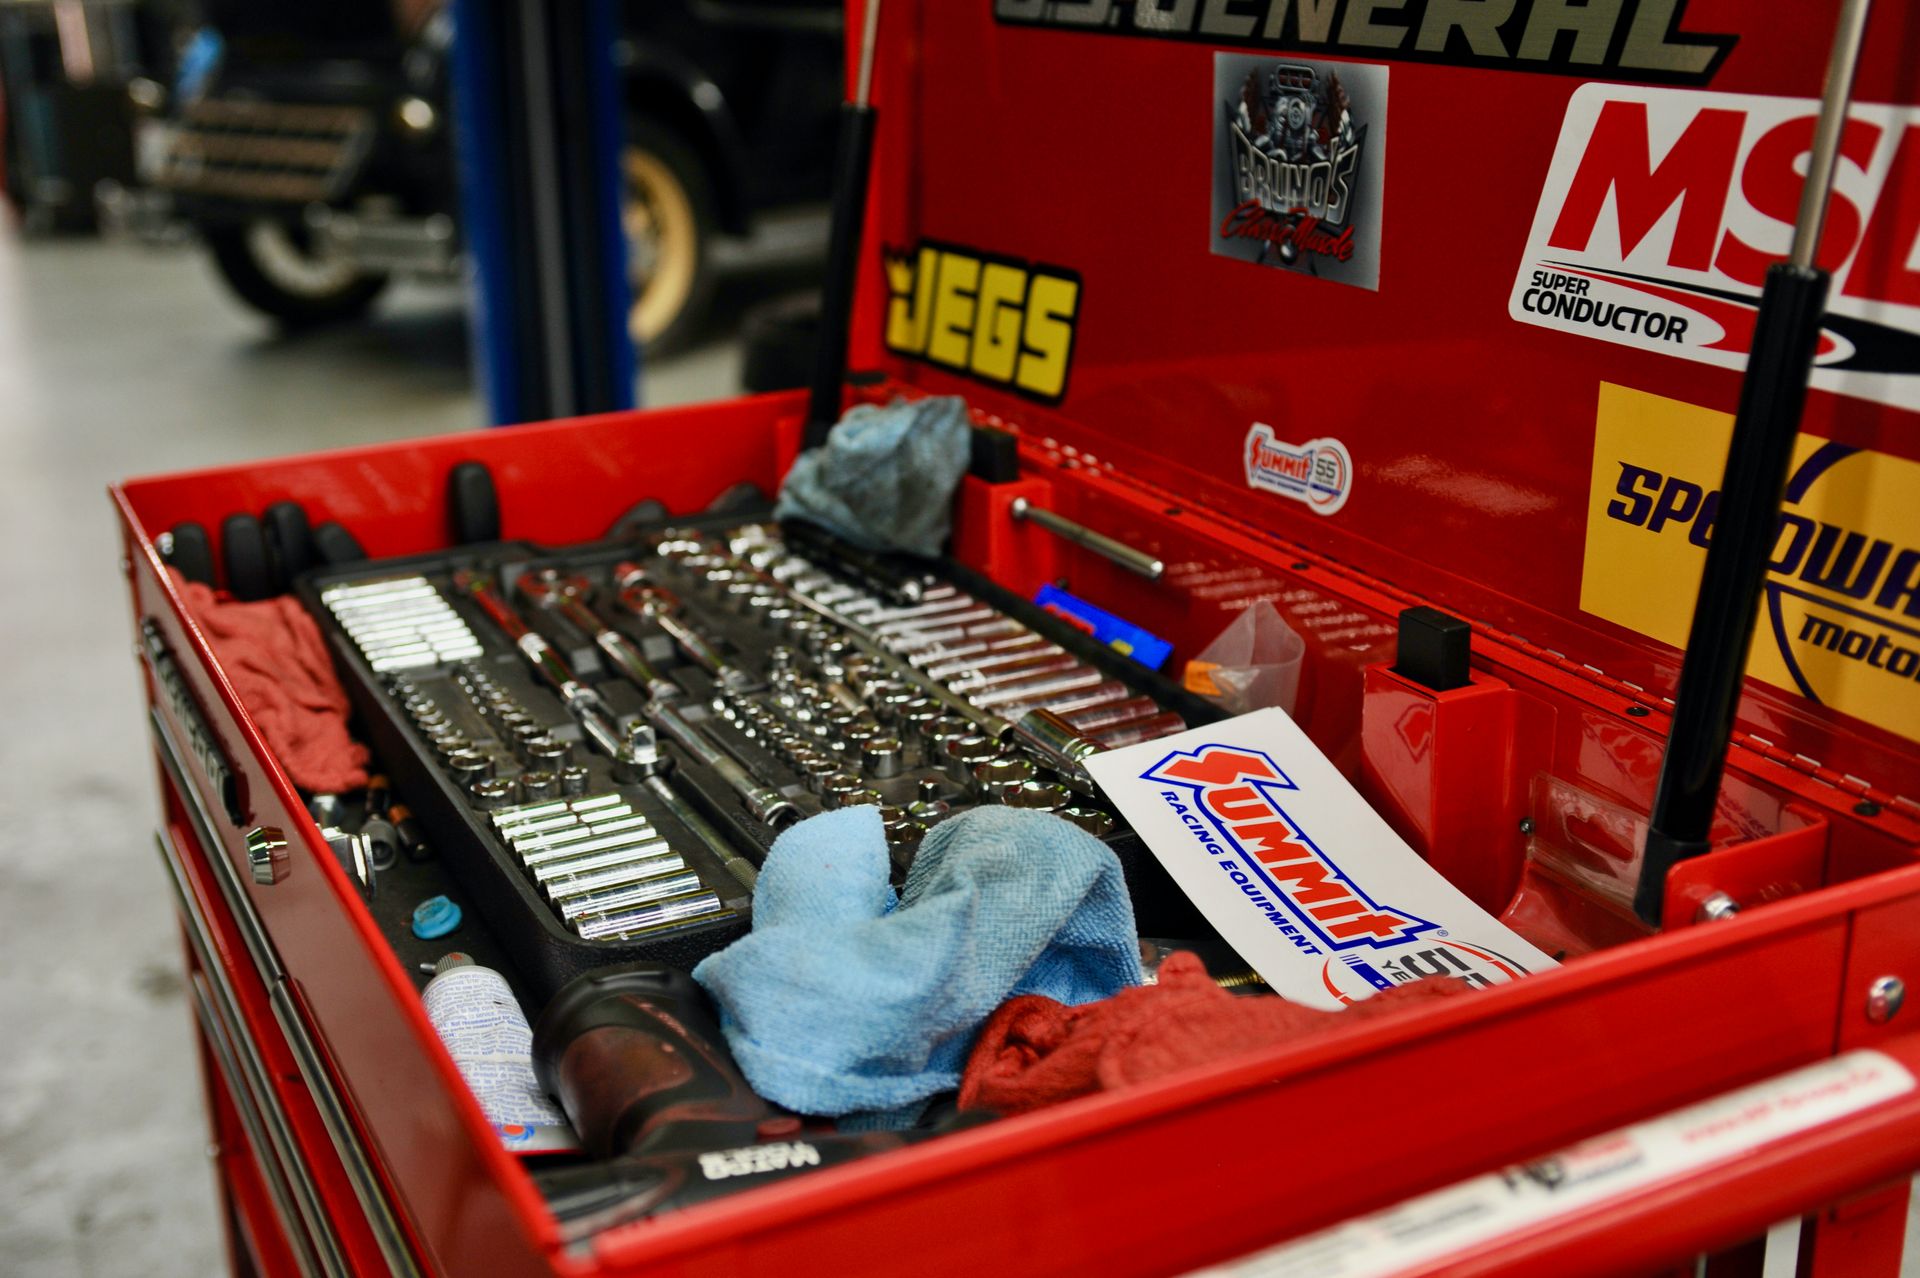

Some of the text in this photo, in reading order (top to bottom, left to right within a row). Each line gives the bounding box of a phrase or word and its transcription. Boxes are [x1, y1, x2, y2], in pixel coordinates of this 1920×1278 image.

[1231, 122, 1358, 225] BRUNO'S
[886, 247, 1079, 398] JEGS
[1522, 288, 1689, 344] CONDUCTOR
[1531, 270, 1590, 296] SUPER
[1606, 461, 1920, 618] SPEDWA
[1798, 612, 1920, 682] moto
[1160, 791, 1324, 956] RACING EQUIPMENT
